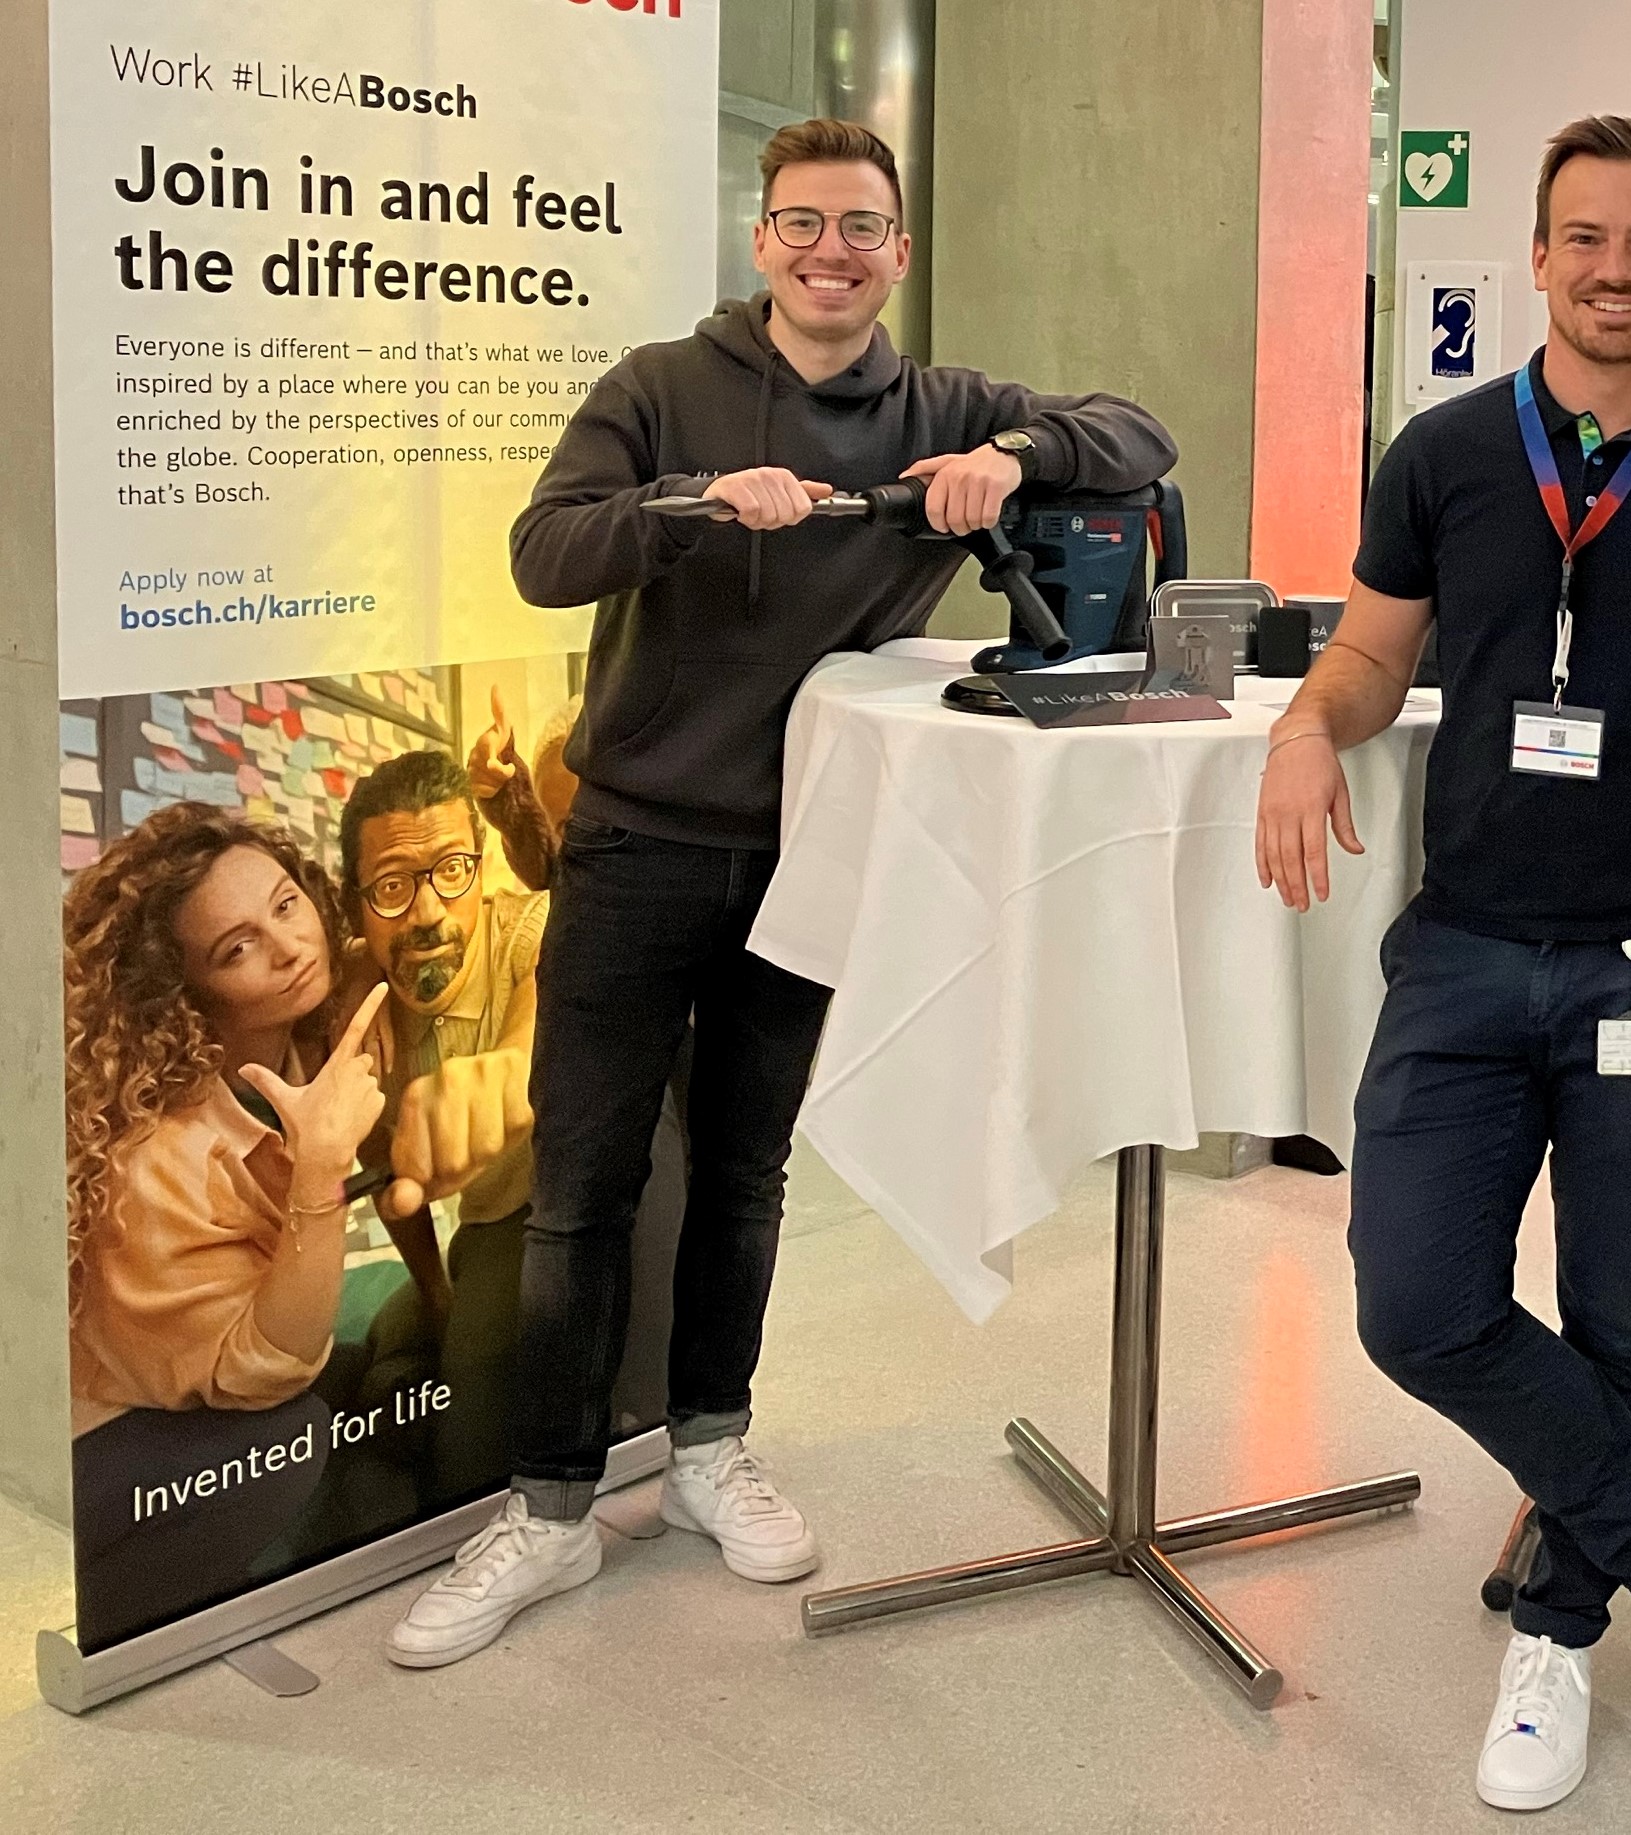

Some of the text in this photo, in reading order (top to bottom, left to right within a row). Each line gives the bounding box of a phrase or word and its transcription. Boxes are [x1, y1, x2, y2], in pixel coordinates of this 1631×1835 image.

[110, 44, 477, 119] Work #LikeABosch
[114, 145, 623, 235] Join in and feel
[114, 229, 589, 307] the difference.
[116, 334, 224, 361] Everyone
[234, 337, 251, 358] is
[260, 337, 351, 360] different
[379, 340, 417, 360] and
[485, 342, 530, 362] what
[536, 348, 564, 363] we
[571, 344, 613, 364] love.
[116, 371, 212, 398] inspired
[223, 372, 249, 399] by
[257, 379, 270, 394] a
[279, 373, 335, 398] place
[342, 374, 407, 394] where
[415, 380, 449, 399] you
[457, 380, 490, 395] can
[498, 375, 520, 395] be
[526, 381, 559, 399] you
[116, 409, 221, 431] enriched
[232, 409, 257, 435] by
[265, 409, 300, 430] the
[309, 409, 439, 434] perspectives
[447, 408, 466, 428] of
[472, 413, 504, 428] our
[117, 446, 157, 468] the
[166, 446, 238, 472] globe.
[247, 444, 384, 469] Cooperation,
[393, 447, 493, 466] openness,
[195, 481, 270, 504] Bosch.
[119, 564, 274, 595] Apply now at
[120, 590, 376, 630] bosch.ch/karriere
[134, 1379, 451, 1522] Invented for life
